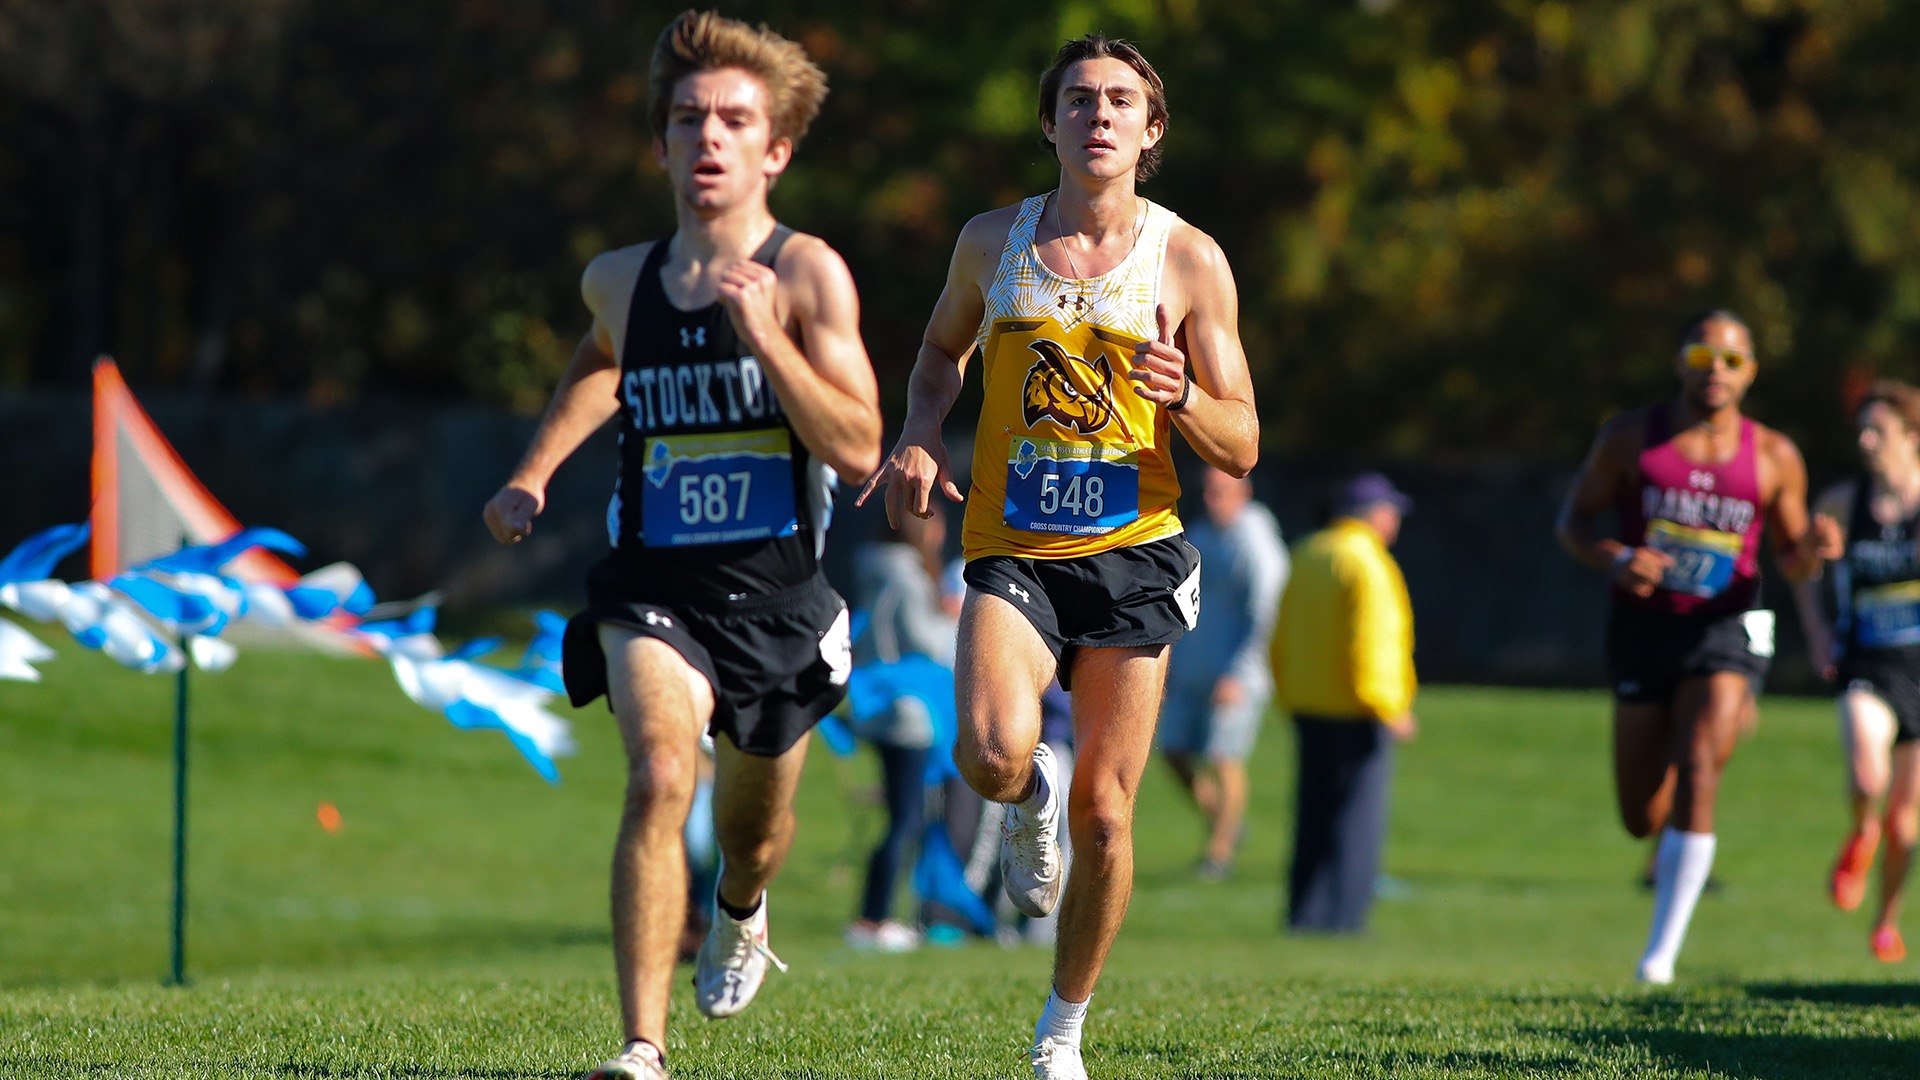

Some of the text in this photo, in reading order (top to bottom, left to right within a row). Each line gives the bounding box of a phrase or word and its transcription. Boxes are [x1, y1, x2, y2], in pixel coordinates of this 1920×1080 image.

[679, 471, 751, 525] 587
[1040, 473, 1104, 517] 548
[1030, 522, 1047, 530] CROSS
[1047, 523, 1072, 532] COUNTRY
[1670, 550, 1716, 583] 27
